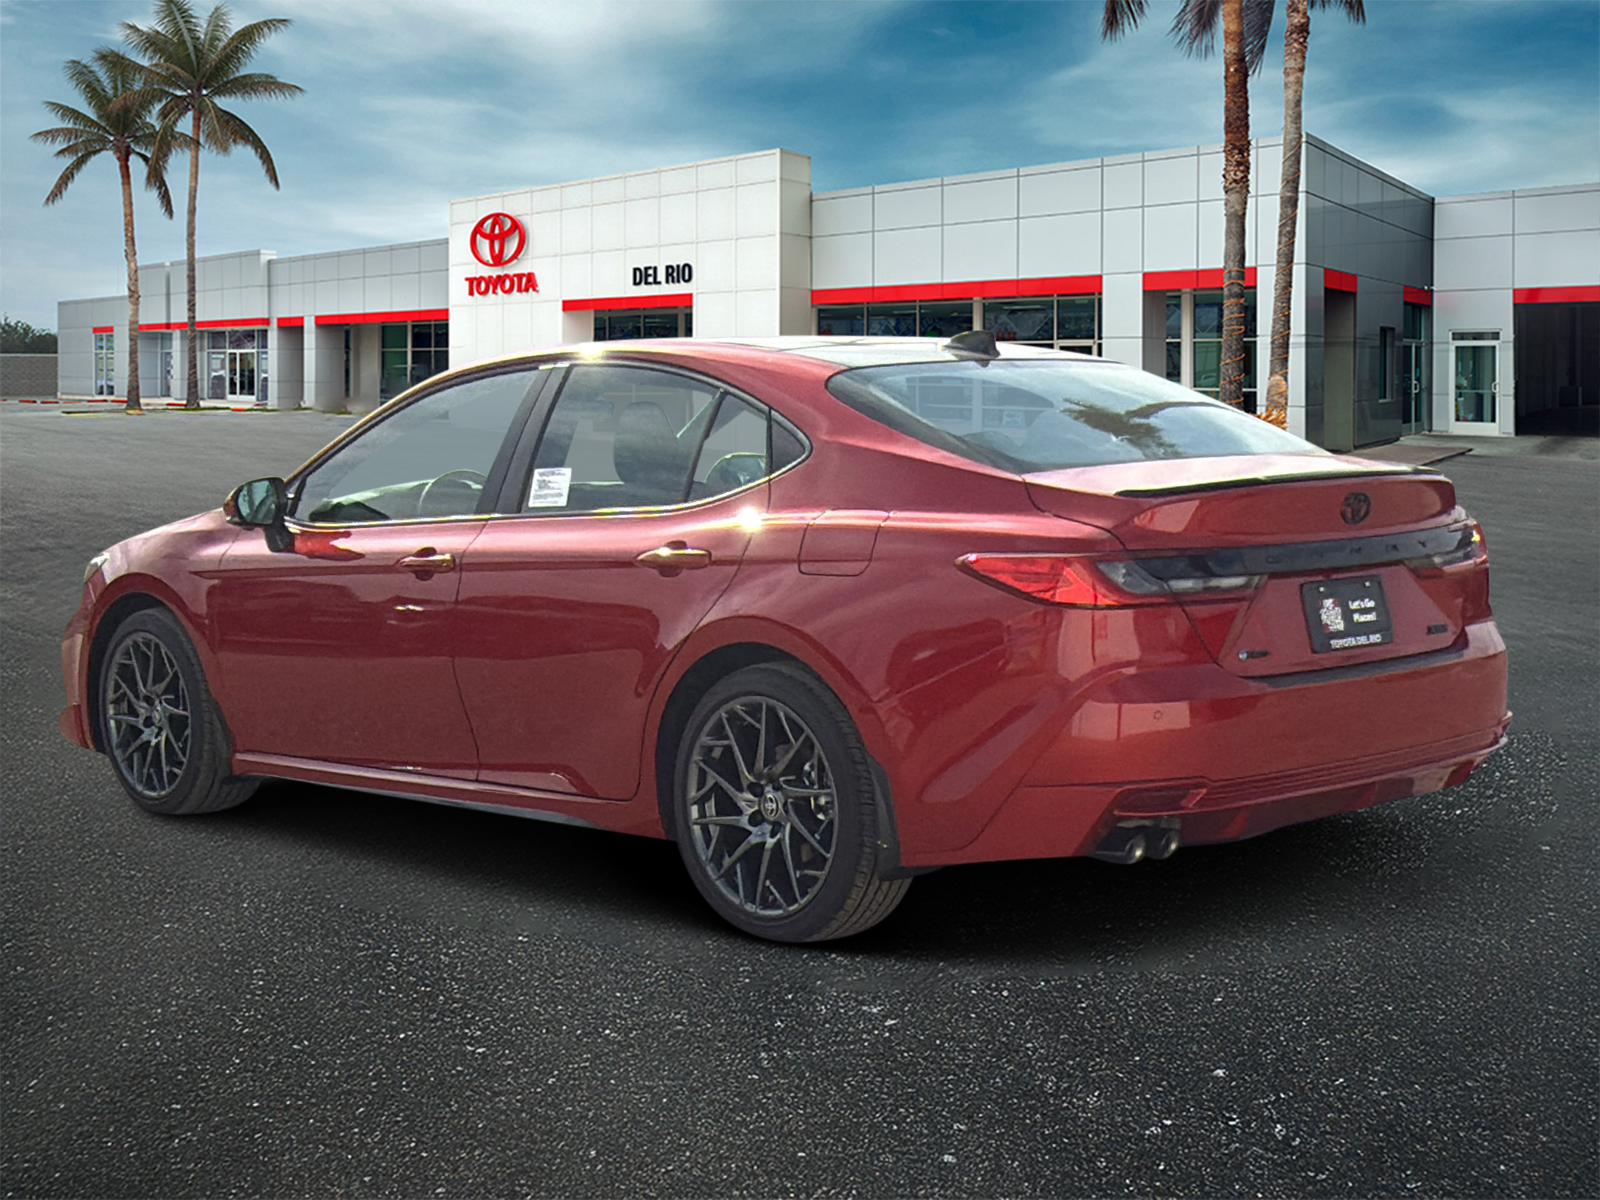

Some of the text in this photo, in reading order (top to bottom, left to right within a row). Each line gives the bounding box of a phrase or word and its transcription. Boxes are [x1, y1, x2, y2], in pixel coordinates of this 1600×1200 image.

[465, 272, 539, 296] TOYOTA
[633, 263, 693, 286] DEL RIO
